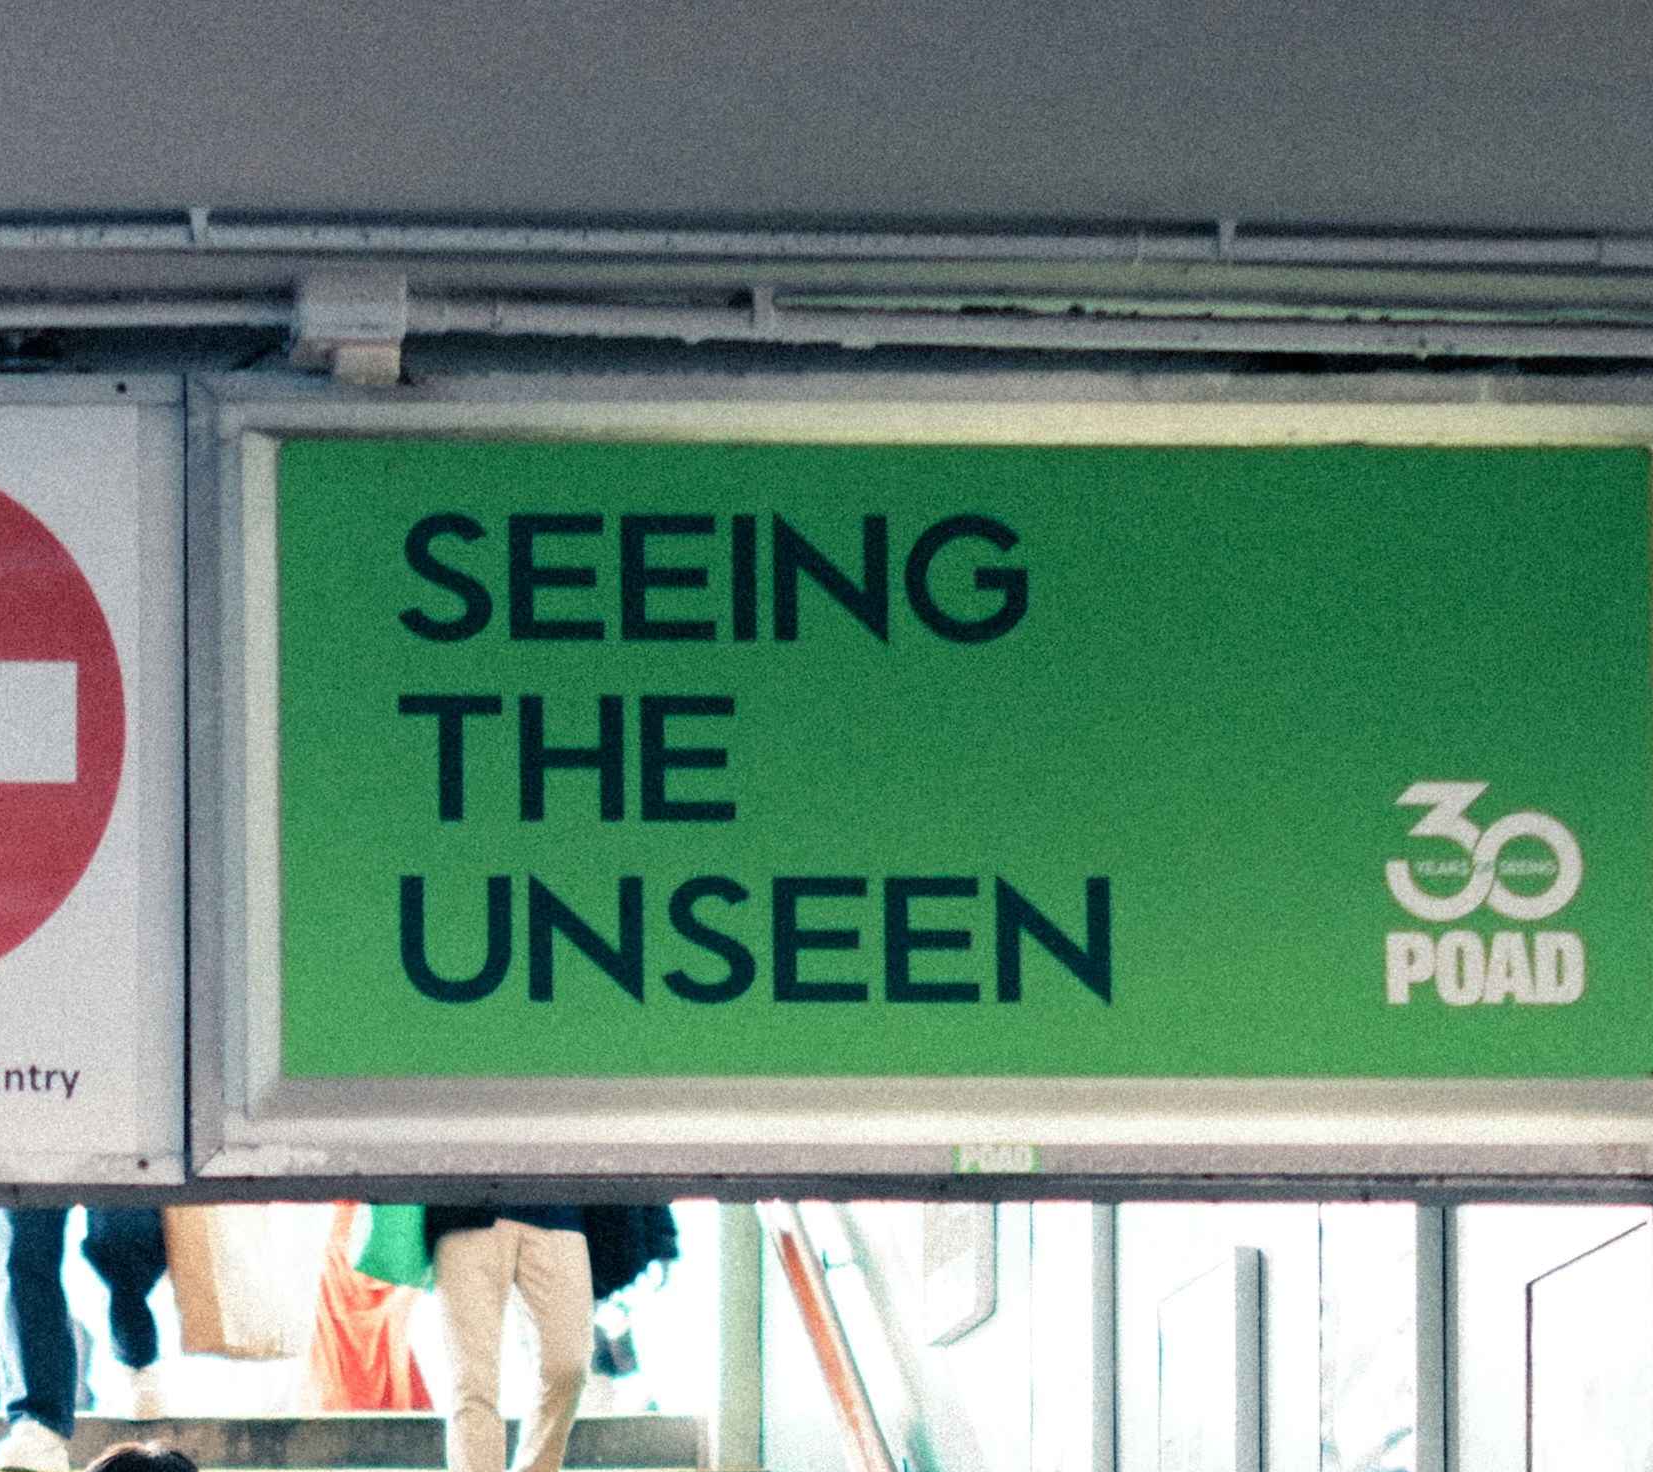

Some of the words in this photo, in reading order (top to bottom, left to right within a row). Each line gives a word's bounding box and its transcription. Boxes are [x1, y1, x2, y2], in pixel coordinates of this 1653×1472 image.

[397, 511, 1030, 643] SEEING
[397, 694, 738, 823] THE
[1385, 780, 1583, 921] 30
[397, 874, 1112, 1005] UNSEEN
[1385, 930, 1586, 1006] POAD
